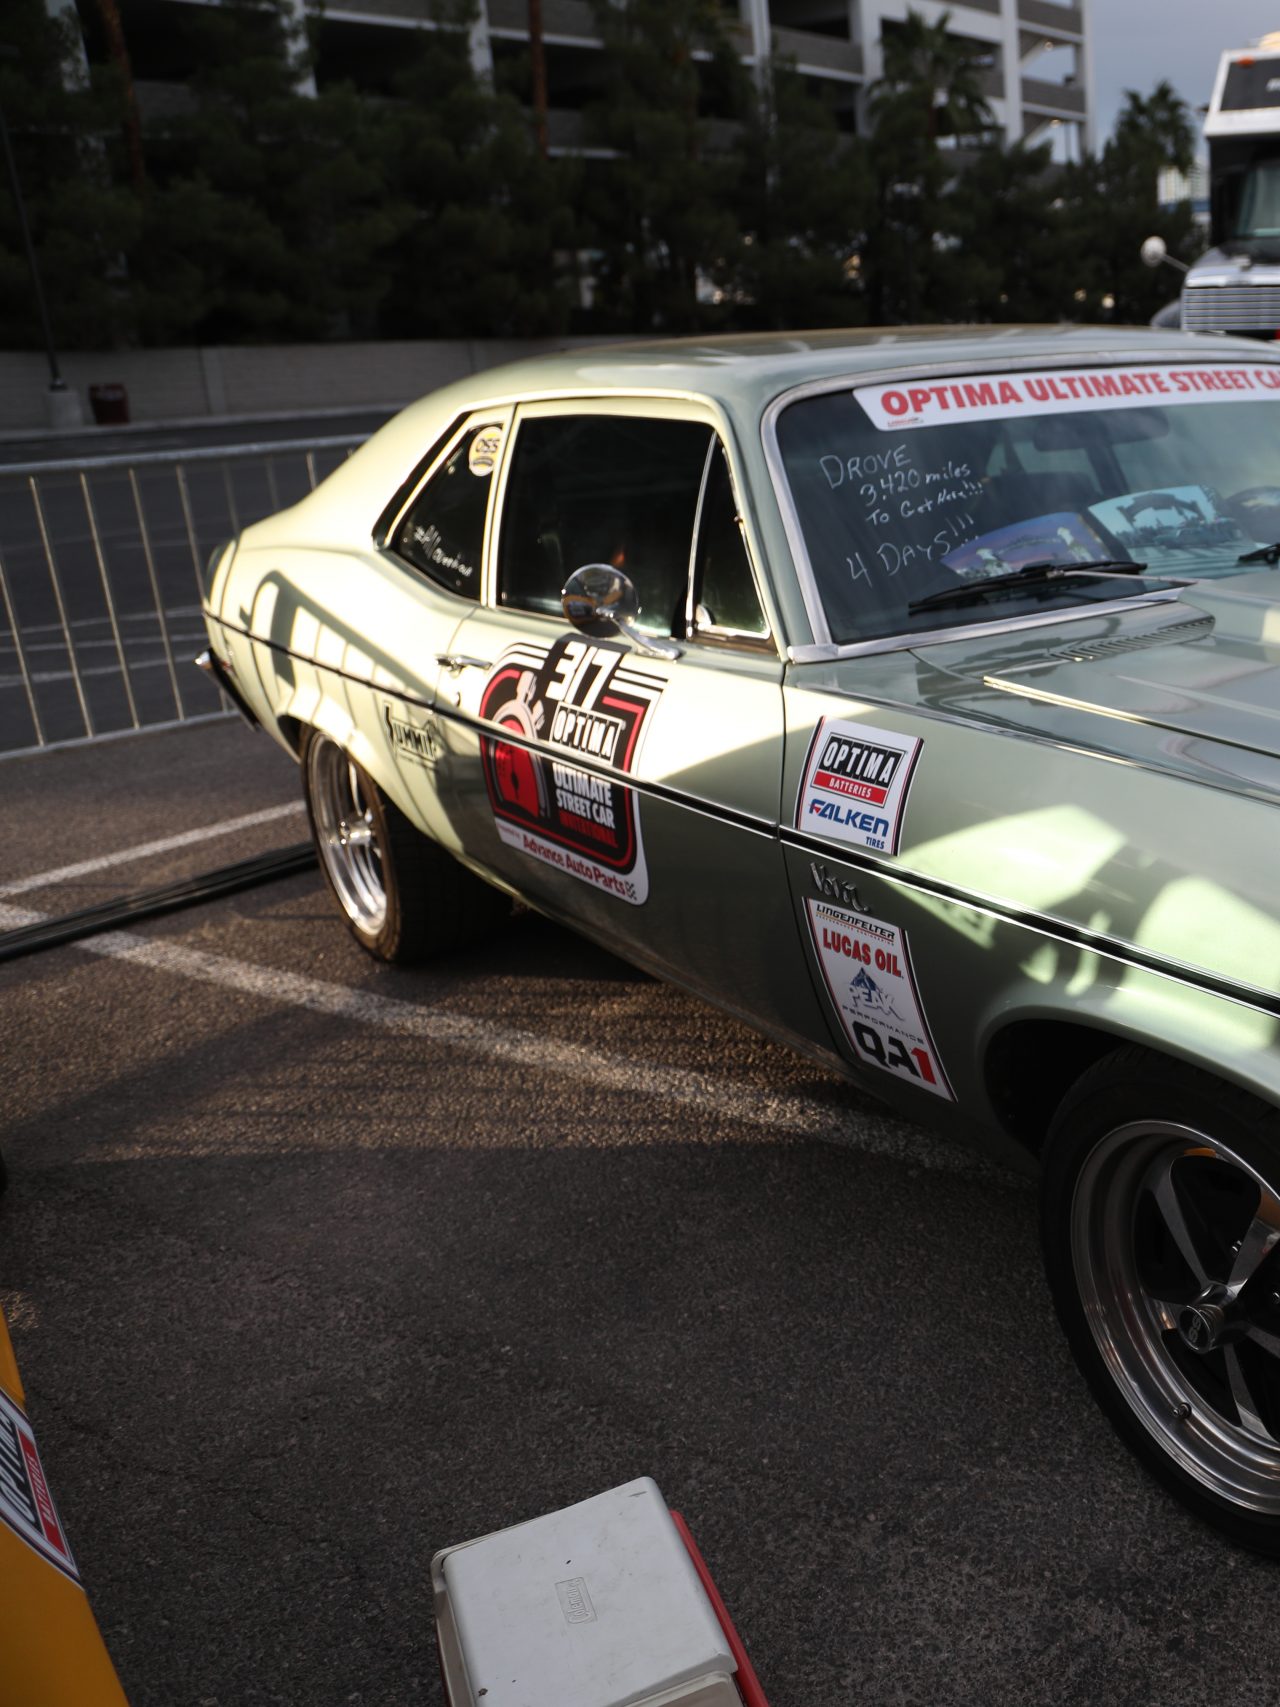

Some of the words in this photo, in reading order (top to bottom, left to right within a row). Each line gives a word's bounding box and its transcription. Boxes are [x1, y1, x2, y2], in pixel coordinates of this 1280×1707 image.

[880, 379, 1024, 417] OPTIMA
[1023, 371, 1171, 402] ULTIMATE
[1168, 369, 1255, 394] STREET
[819, 444, 912, 489] DROVE
[925, 461, 971, 484] miles
[900, 498, 933, 518] Get
[846, 552, 873, 588] 4
[544, 640, 622, 711] 317
[385, 705, 435, 759] SUMMIT
[553, 709, 616, 758] OPTIMA
[822, 741, 897, 784] OPTIMA
[552, 762, 613, 807] ULTIMATE
[828, 777, 873, 798] BATTERIES
[556, 788, 592, 821] STREET
[592, 803, 616, 830] CAR
[808, 798, 890, 838] FALKEN
[865, 835, 885, 850] TIRES
[522, 834, 565, 867] Advance
[565, 854, 594, 880] Auto
[593, 866, 626, 896] Parts
[810, 861, 870, 912] Nova
[816, 903, 896, 940] LINGENFELTER
[823, 927, 872, 966] LUCAS
[874, 947, 902, 978] OIL
[841, 1004, 925, 1045] PERFORMANCE
[848, 984, 906, 1022] PEAK
[851, 1020, 938, 1086] QA1
